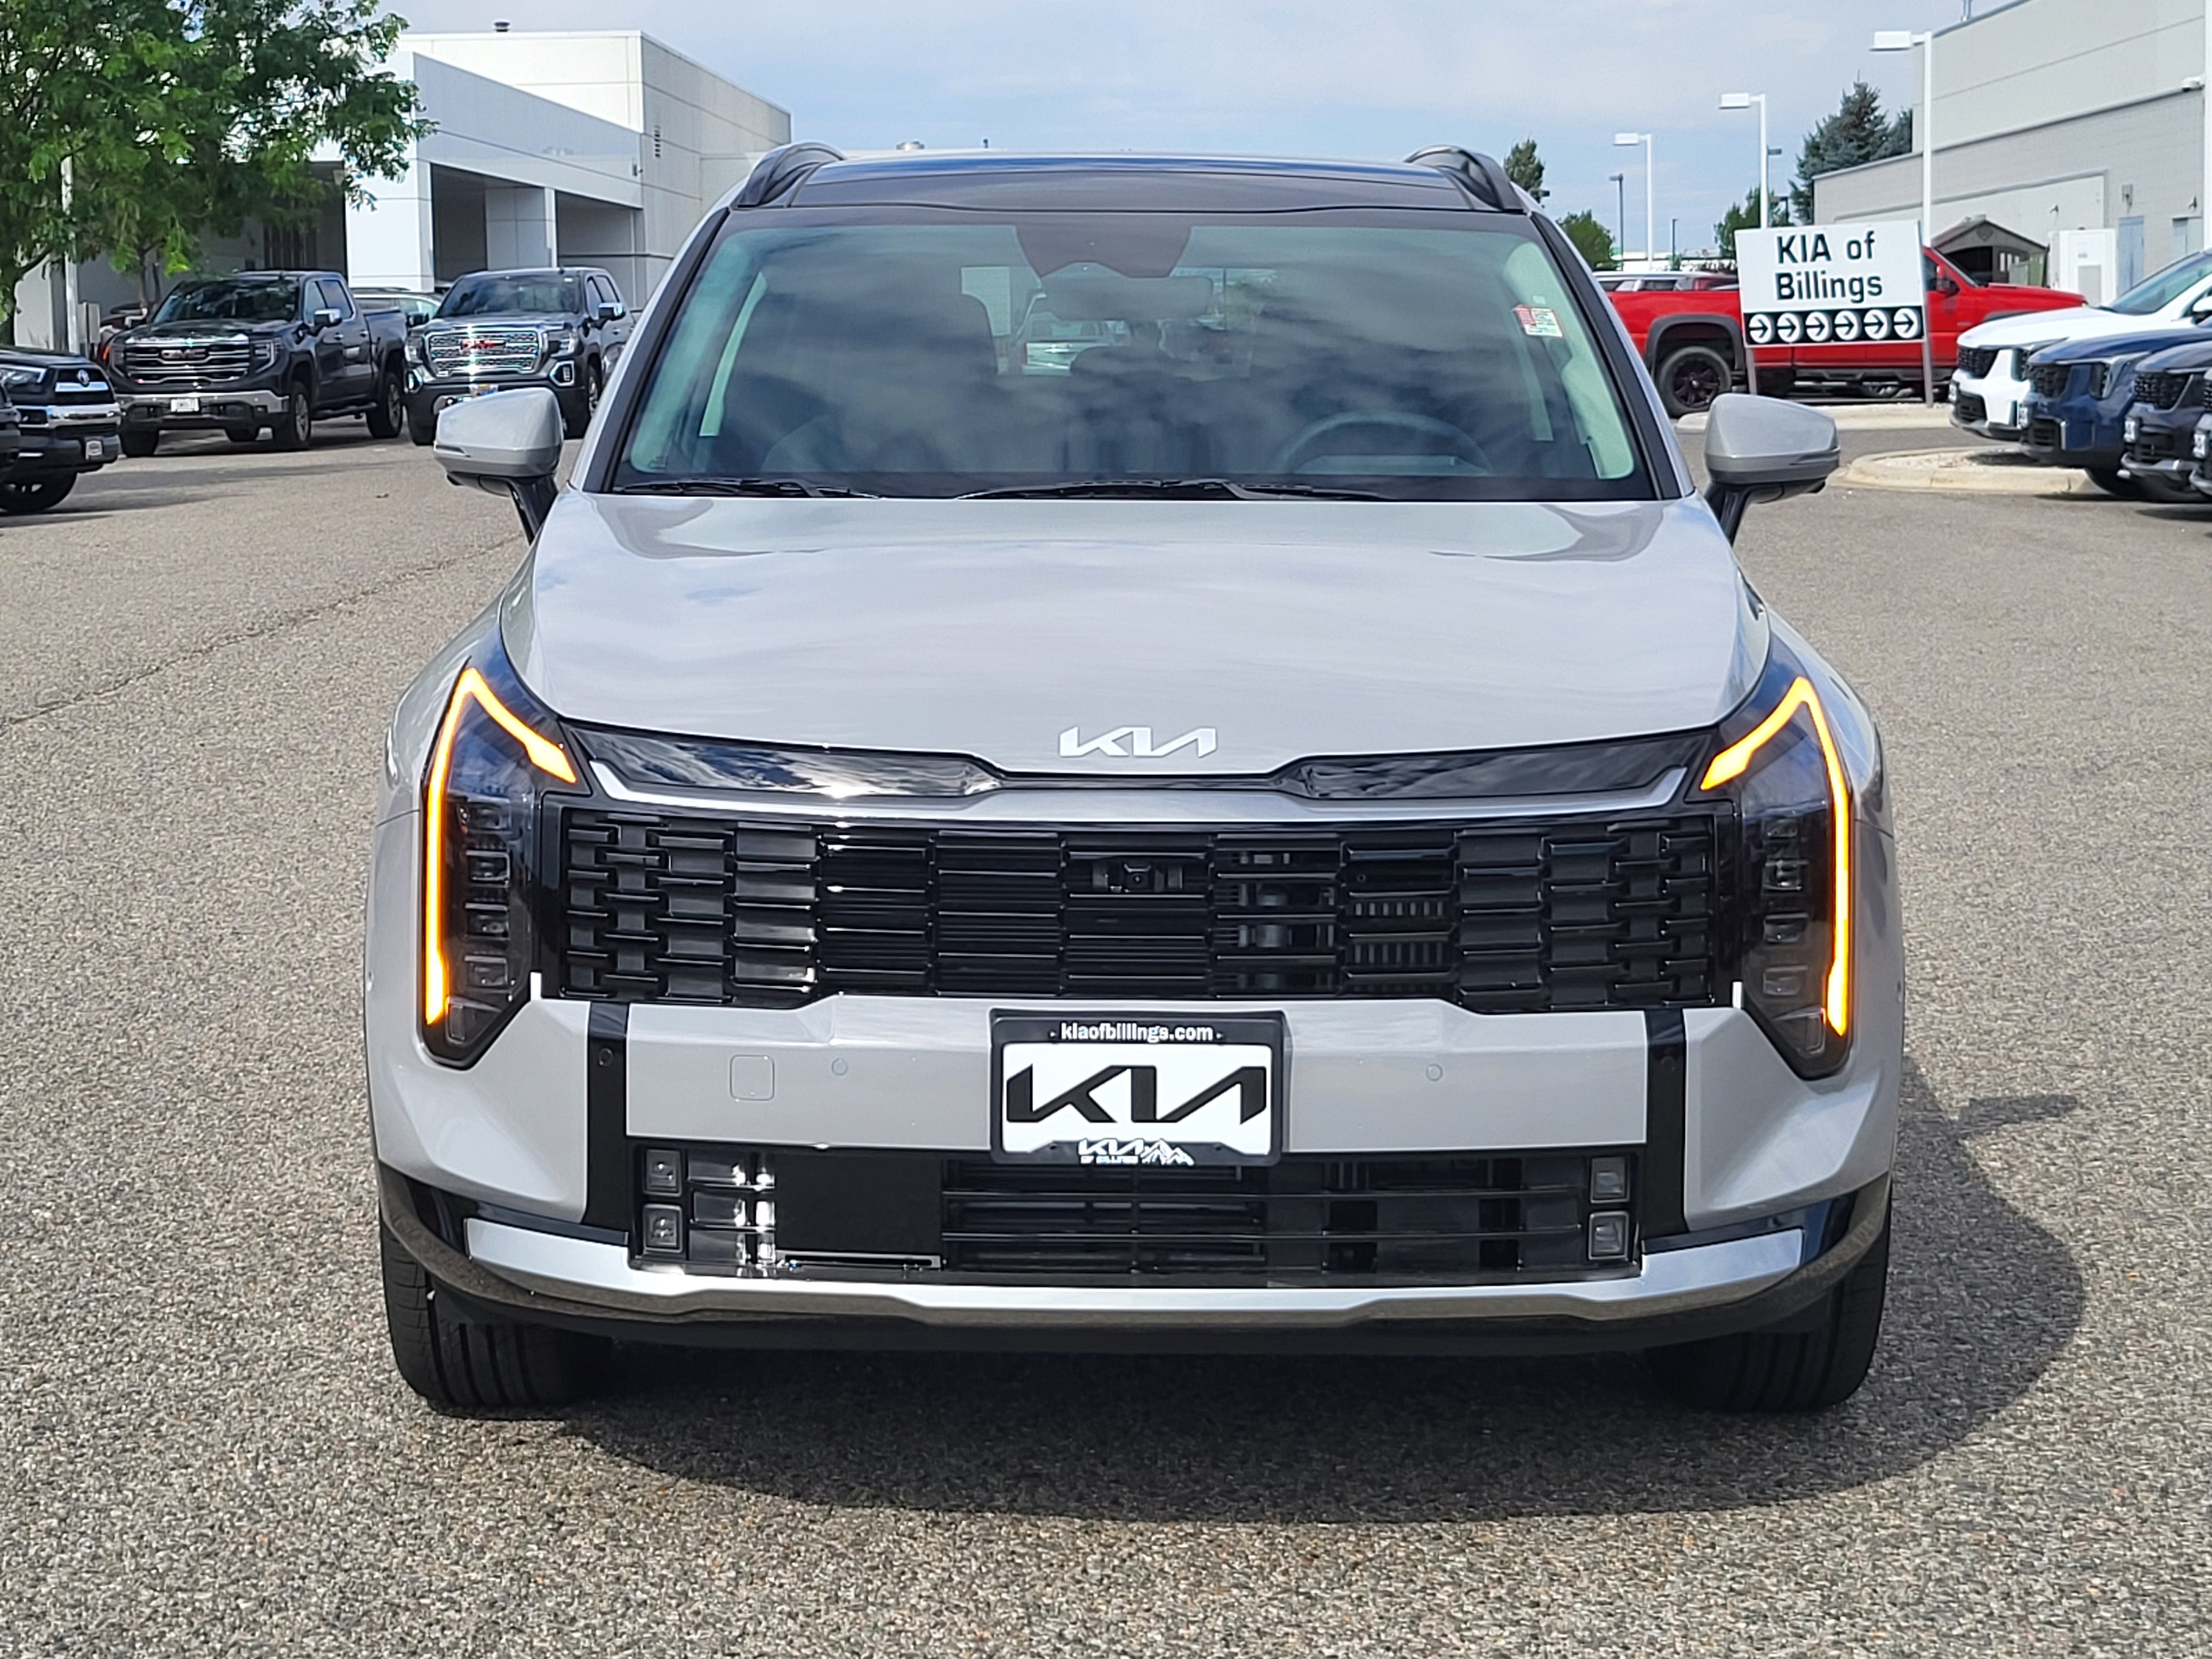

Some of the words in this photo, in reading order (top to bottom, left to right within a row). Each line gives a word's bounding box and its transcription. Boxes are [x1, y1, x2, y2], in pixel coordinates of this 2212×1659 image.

[1776, 233, 1832, 264] KIA
[1846, 230, 1875, 260] of
[1775, 270, 1883, 304] Billings
[161, 348, 206, 359] GMC
[1059, 726, 1217, 758] KIA
[1006, 1063, 1267, 1125] KIA
[1078, 1138, 1144, 1155] KIA
